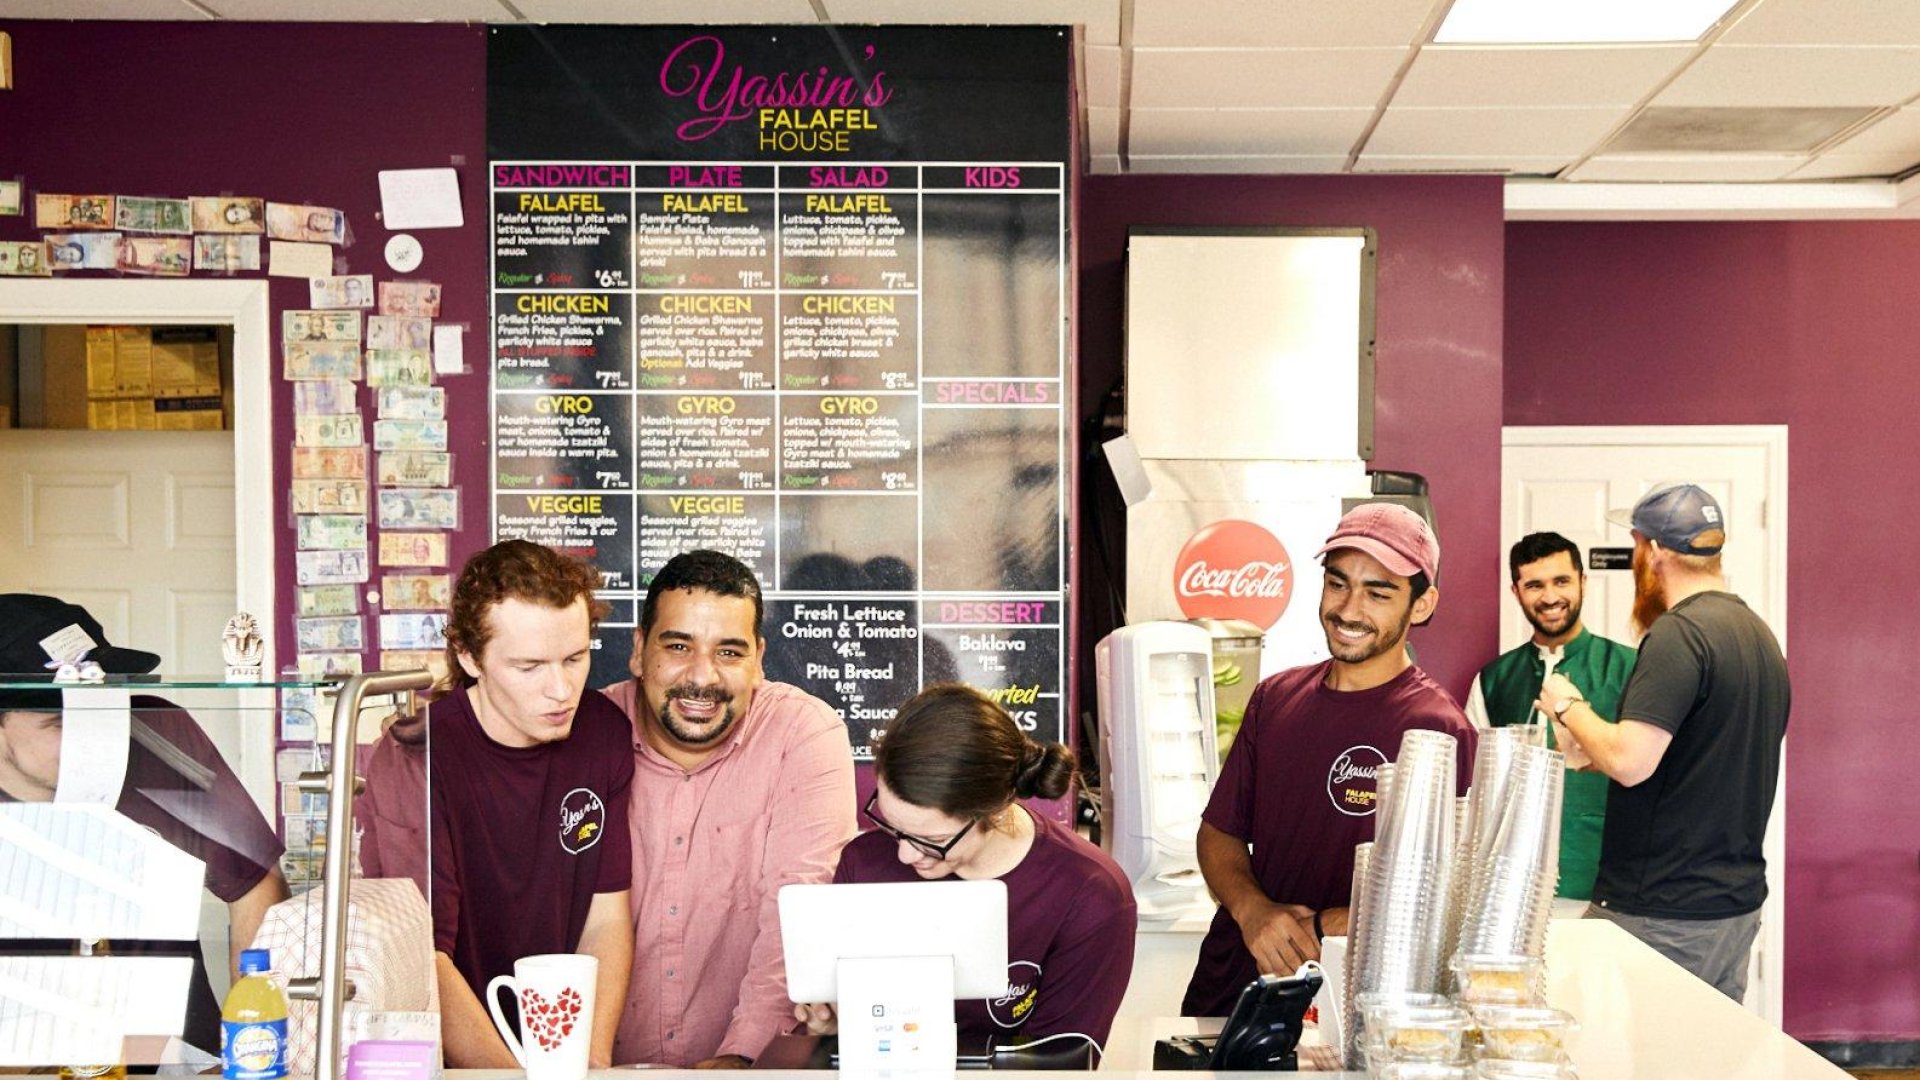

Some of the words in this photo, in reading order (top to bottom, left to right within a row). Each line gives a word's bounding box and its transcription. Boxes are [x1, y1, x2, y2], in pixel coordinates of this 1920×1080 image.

[658, 34, 895, 143] Yassin's
[759, 108, 879, 130] FALAFEL
[758, 131, 851, 152] HOUSE
[495, 166, 629, 187] SANDWICH
[669, 166, 743, 187] PLATE
[809, 166, 889, 187] SALAD
[964, 166, 1022, 187] KIDS
[519, 194, 606, 212] FALAFEL
[662, 194, 748, 212] FALAFEL
[805, 195, 892, 213] FALAFEL
[497, 214, 528, 225] Falafel
[531, 214, 572, 225] wrapped
[585, 214, 605, 225] pita
[607, 214, 628, 225] with
[497, 235, 516, 245] and
[518, 235, 570, 245] homemade
[516, 295, 609, 314] CHICKEN
[659, 295, 753, 314] CHICKEN
[802, 296, 895, 314] CHICKEN
[935, 382, 1049, 403] SPECIALS
[534, 396, 593, 414] GYRO
[677, 396, 736, 414] GYRO
[819, 397, 878, 415] GYRO
[576, 415, 601, 426] Gyro
[719, 415, 744, 426] Gyro
[746, 415, 771, 426] meat
[526, 495, 603, 513] VEGGIE
[669, 496, 745, 514] VEGGIE
[499, 515, 546, 525] Seasoned
[548, 515, 577, 527] grilled
[641, 515, 689, 525] Seasoned
[690, 515, 719, 527] grilled
[722, 515, 757, 527] veggies
[1179, 560, 1290, 598] Coca-Cola
[794, 604, 838, 621] Fresh
[843, 604, 906, 621] Lettuce
[939, 602, 1045, 623] DESSERT
[782, 622, 833, 639] Onion
[837, 622, 851, 639] &
[855, 622, 918, 639] Tomato
[959, 635, 1026, 651] Baklava
[807, 663, 839, 680] Pita
[844, 663, 894, 680] Bread
[849, 704, 898, 720] Sauce
